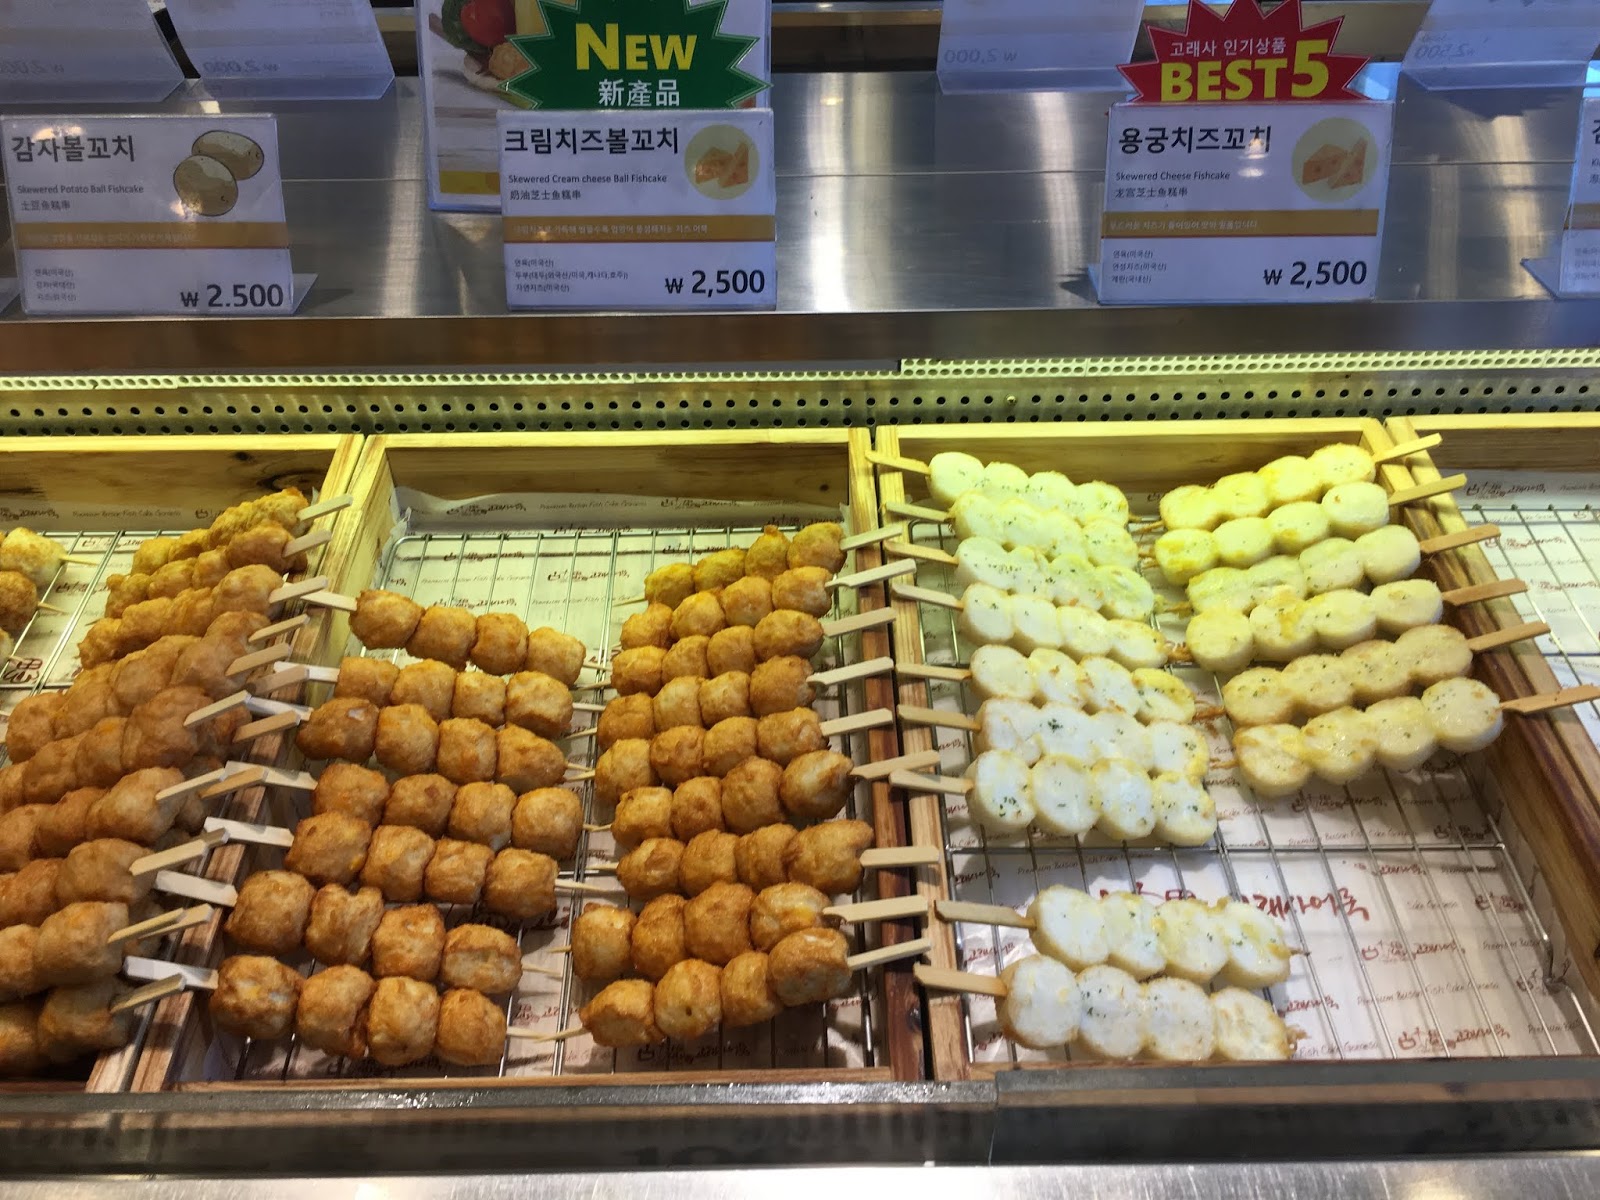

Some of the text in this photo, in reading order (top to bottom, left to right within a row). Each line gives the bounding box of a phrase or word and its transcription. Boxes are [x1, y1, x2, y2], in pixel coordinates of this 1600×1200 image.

[575, 23, 697, 71] NEW
[1170, 37, 1287, 57] 고래사 인기상품
[598, 79, 680, 107] 新產品
[11, 135, 135, 162] 감자볼꼬치
[504, 128, 679, 154] 크림치즈볼꼬치
[1118, 126, 1272, 154] 용궁치즈꼬치
[17, 184, 144, 194] Skewered Potato Ball Fishcake
[508, 174, 667, 184] Skewered Cream cheese Ball Fishcake
[1116, 171, 1230, 181] Skewered Cheese Fishcake
[691, 270, 765, 298] 2,500
[1290, 261, 1367, 289] 2,500
